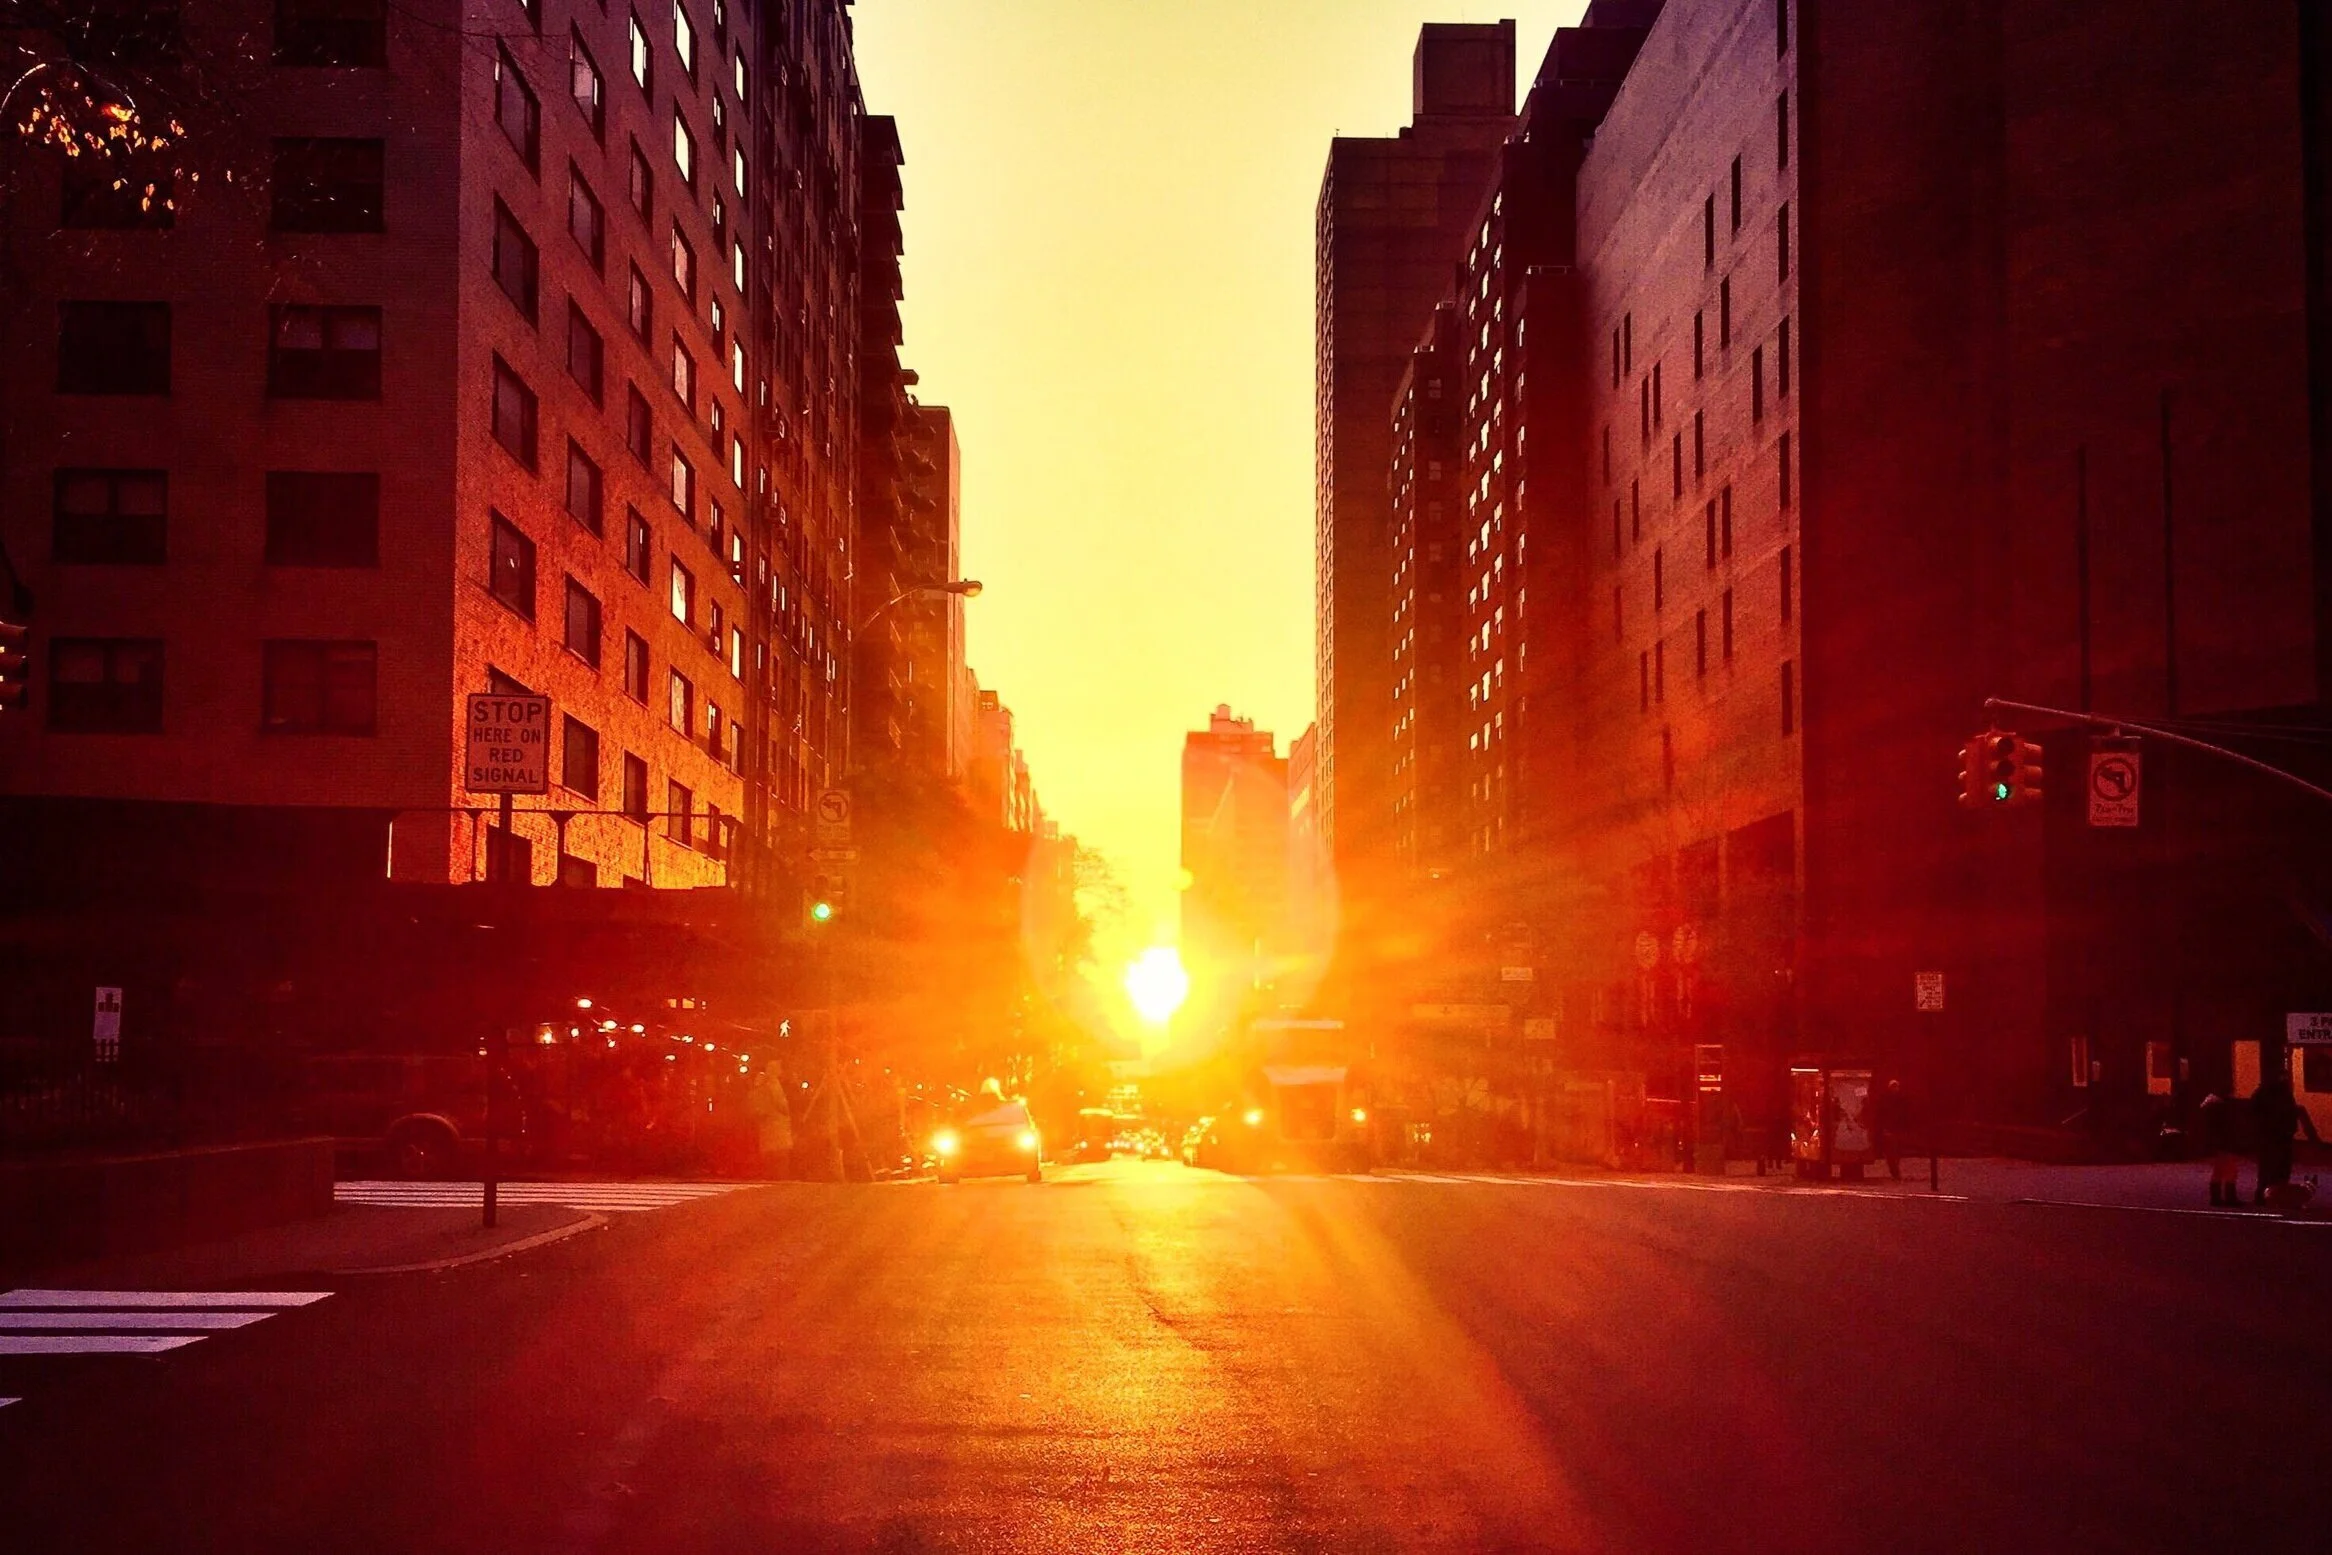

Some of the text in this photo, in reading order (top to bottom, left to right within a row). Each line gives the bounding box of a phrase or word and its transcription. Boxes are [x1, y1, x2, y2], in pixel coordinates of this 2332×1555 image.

[474, 701, 542, 723] STOP
[473, 727, 541, 744] HERE ON
[489, 747, 524, 763] RED
[473, 767, 539, 784] SIGNAL
